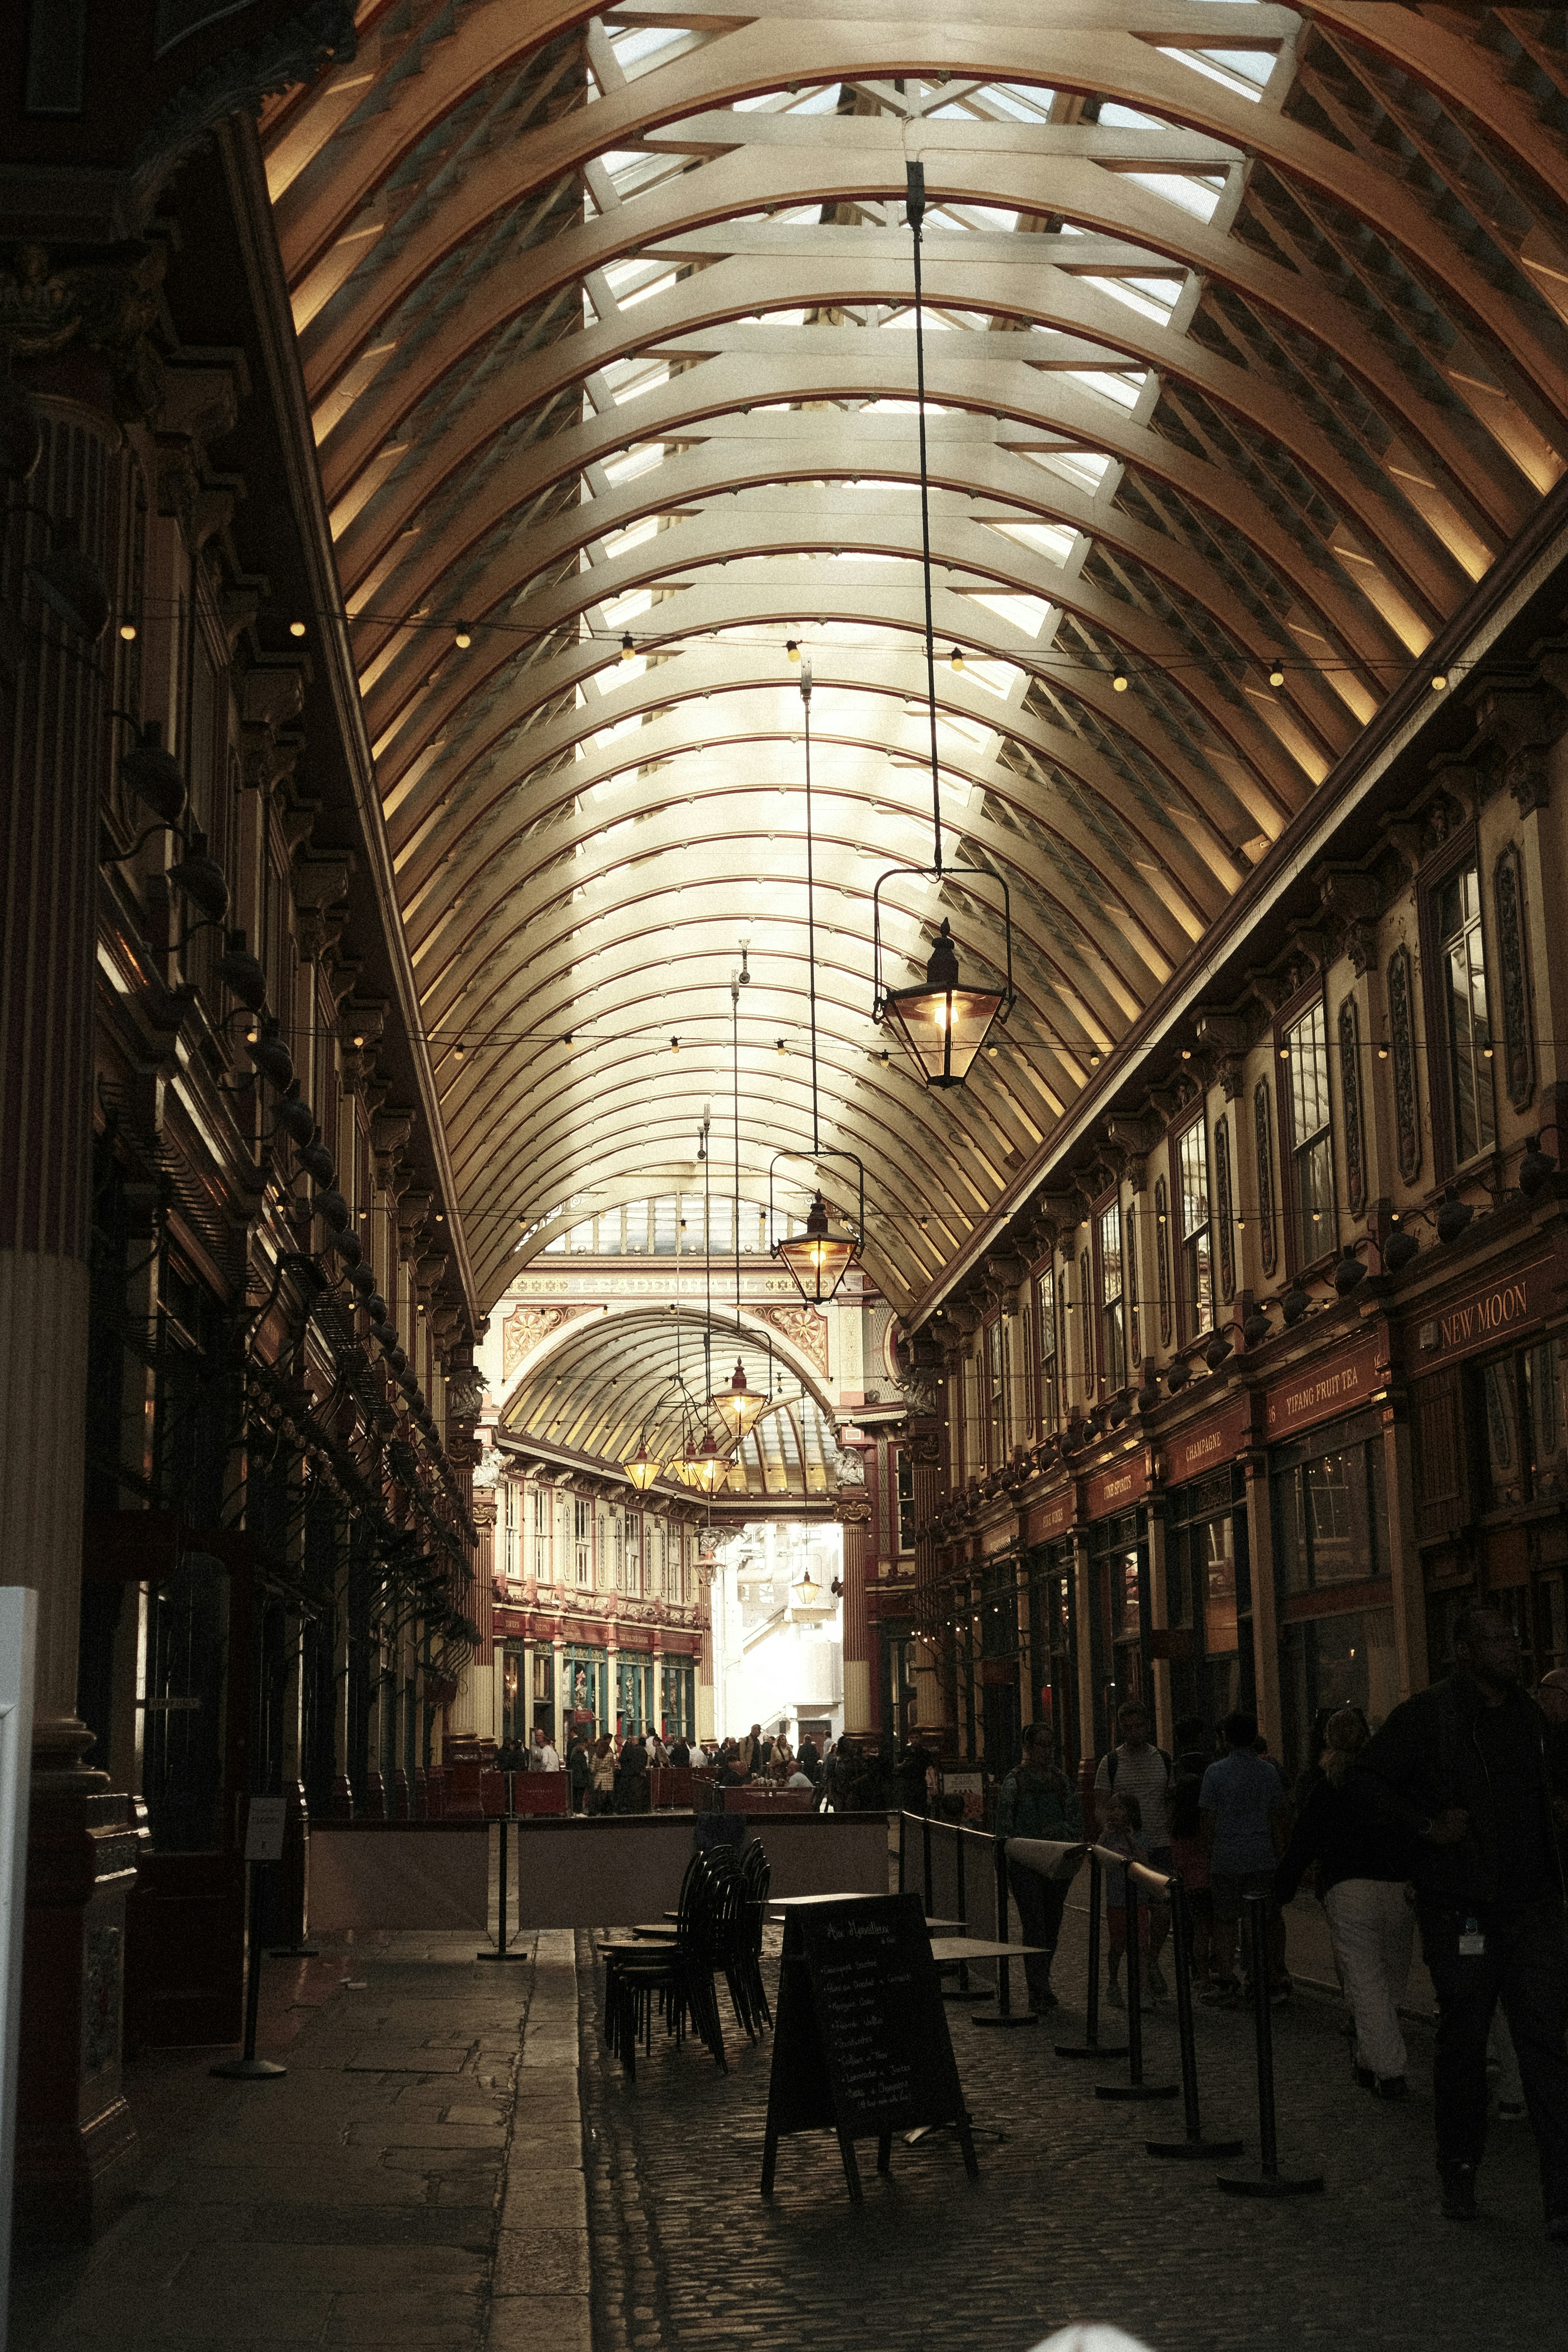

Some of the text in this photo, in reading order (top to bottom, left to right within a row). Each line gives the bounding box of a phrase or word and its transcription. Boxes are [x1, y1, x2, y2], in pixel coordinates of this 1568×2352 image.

[577, 1278, 757, 1293] LEADENHALL
[1441, 1281, 1526, 1349] NEW MOON
[1269, 1366, 1358, 1424] 16 YIFANG FRUIT TEA
[1186, 1431, 1221, 1462] CHAMPAGNE
[1104, 1475, 1132, 1501] FINE SPIRITS
[505, 1620, 520, 1629] TAVERN
[827, 1919, 890, 1941] Aux Merveilleux
